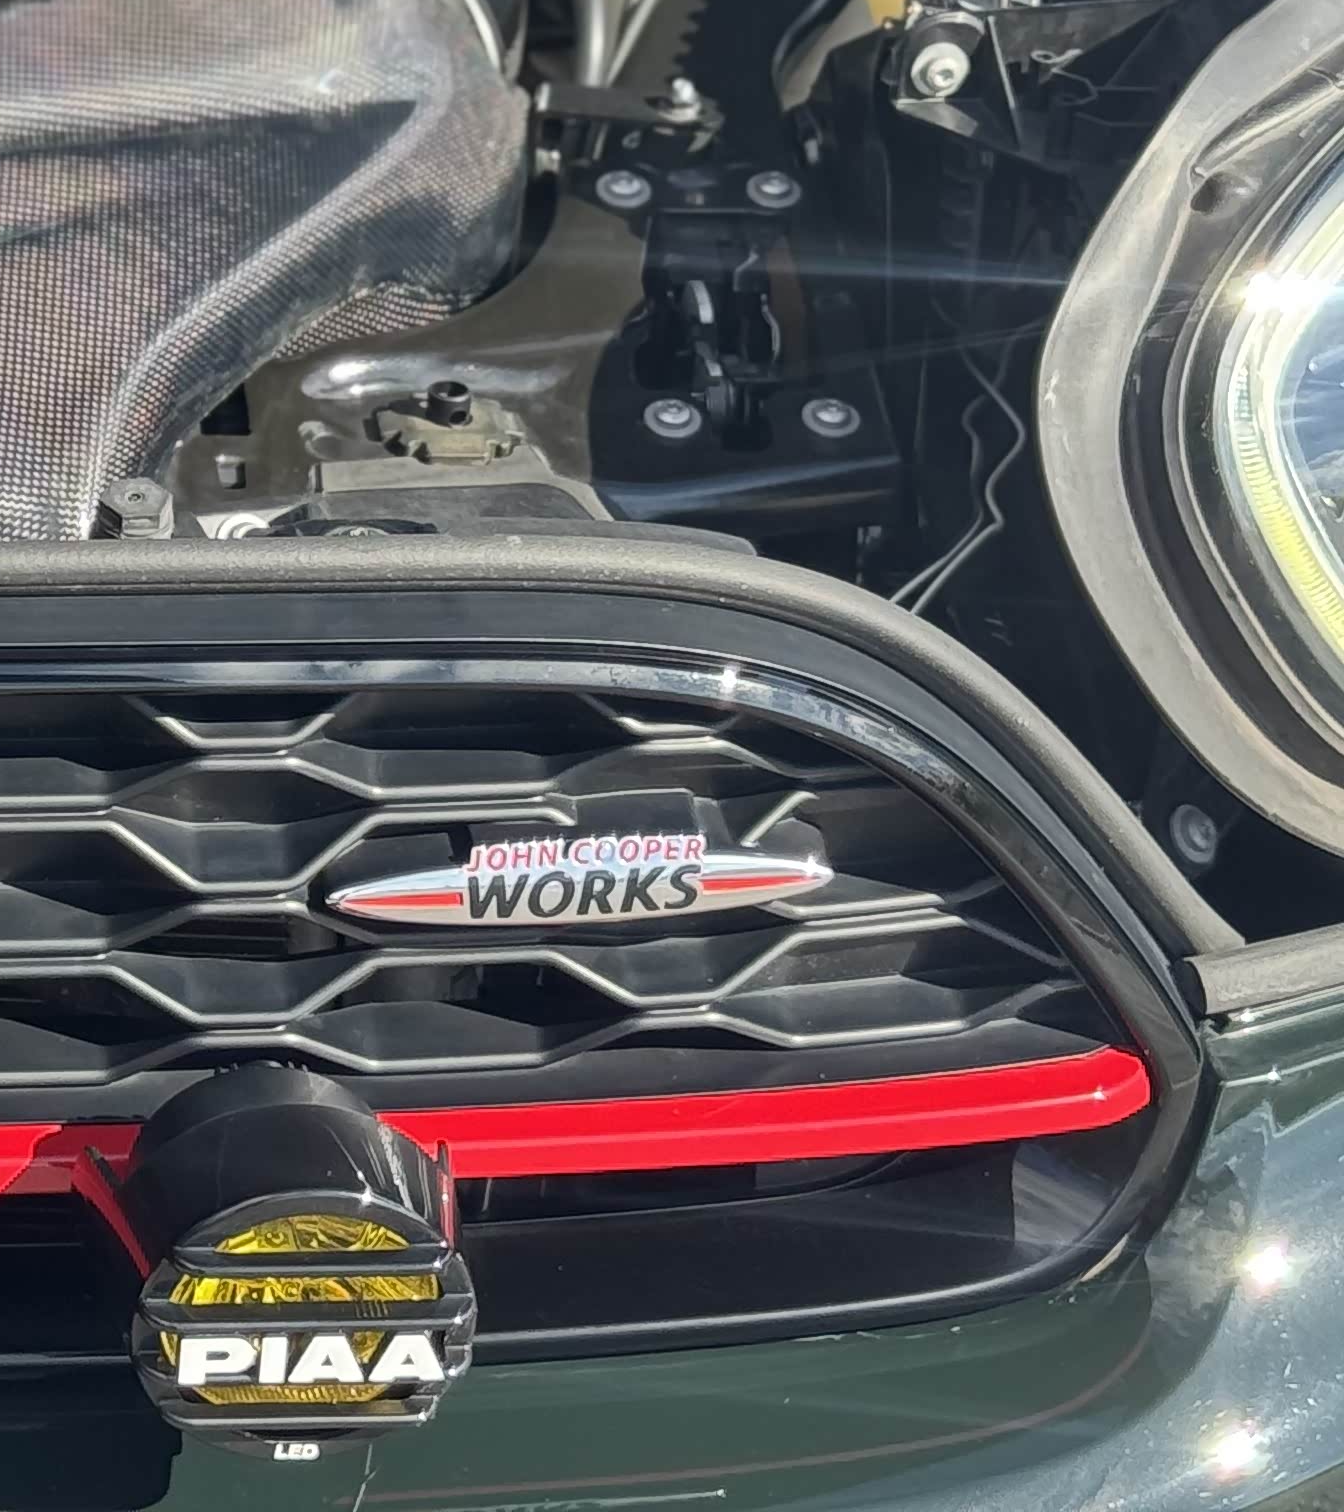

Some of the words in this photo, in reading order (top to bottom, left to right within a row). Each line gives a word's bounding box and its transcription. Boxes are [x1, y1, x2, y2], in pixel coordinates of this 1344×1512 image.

[467, 842, 559, 873] JOHN
[573, 838, 704, 865] COOPER
[467, 863, 704, 920] WORKS
[177, 1333, 446, 1386] PIAA
[273, 1442, 321, 1461] LED
